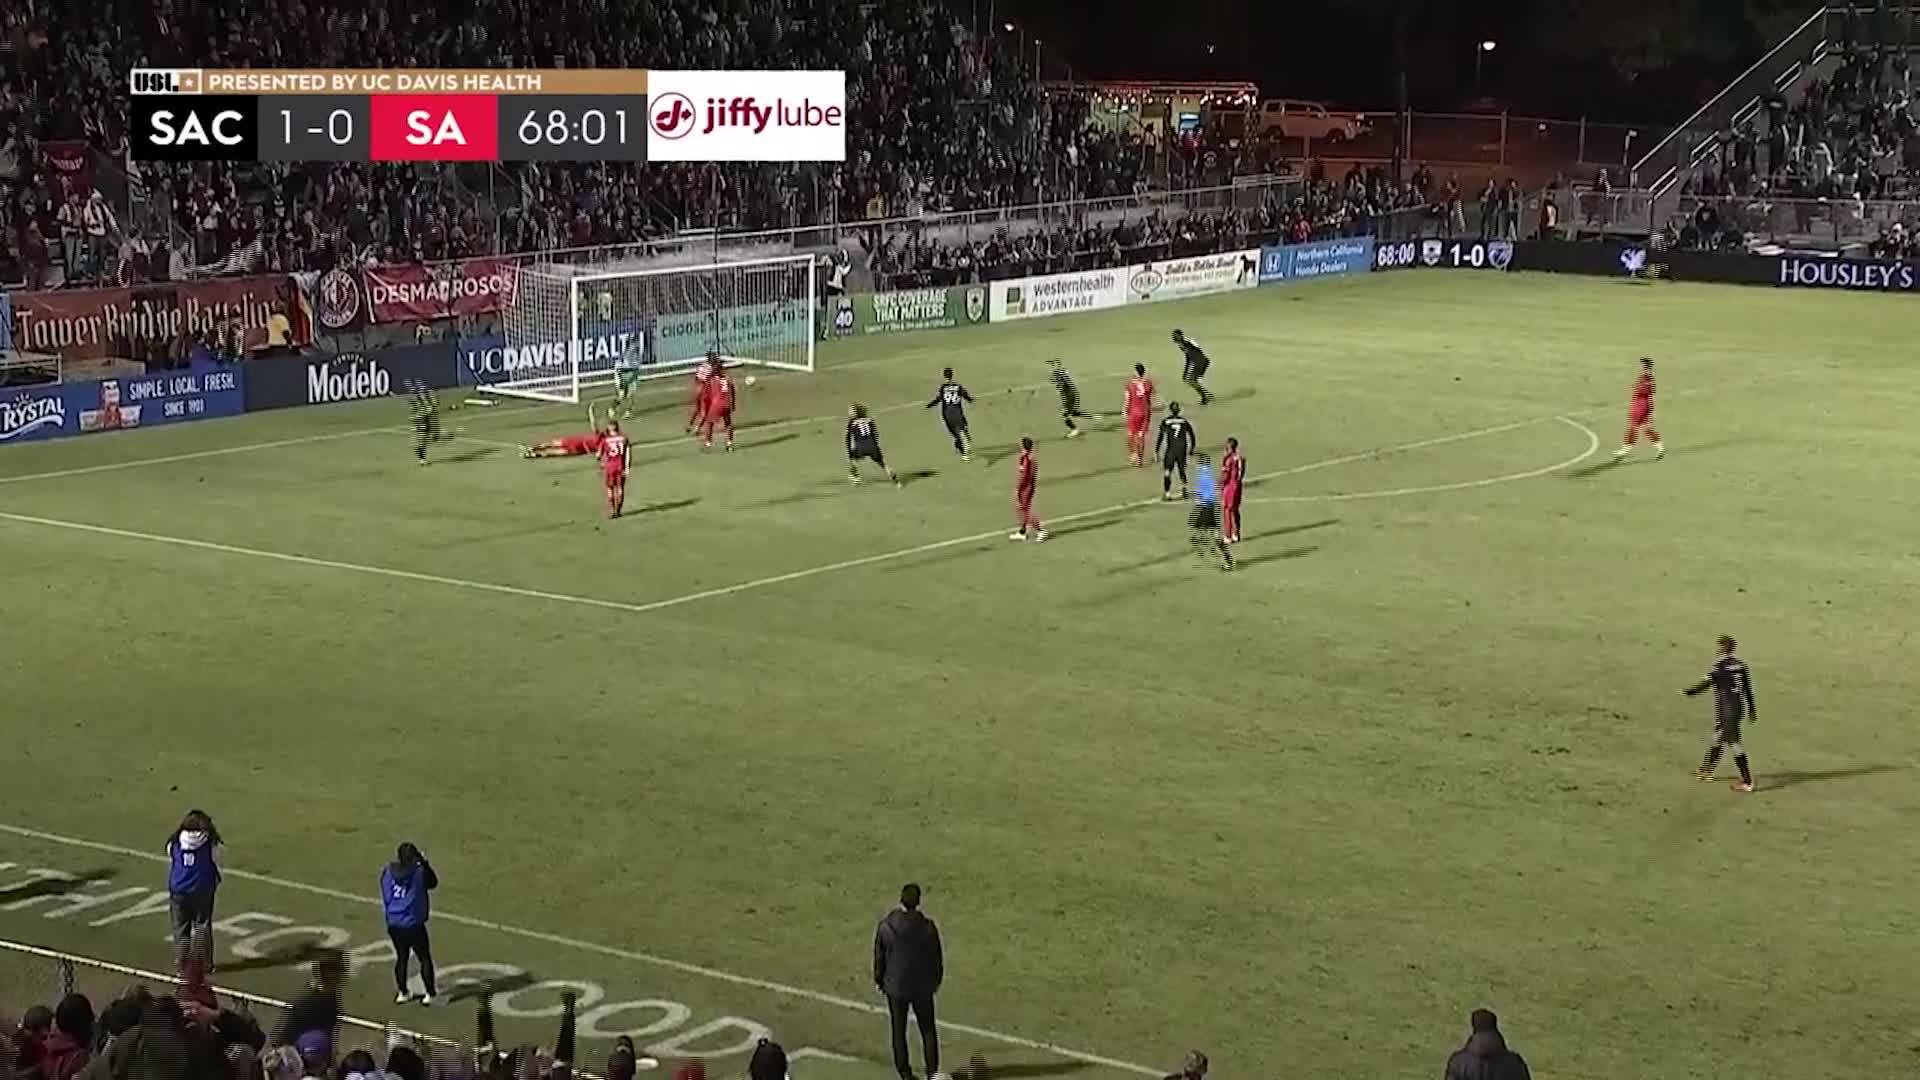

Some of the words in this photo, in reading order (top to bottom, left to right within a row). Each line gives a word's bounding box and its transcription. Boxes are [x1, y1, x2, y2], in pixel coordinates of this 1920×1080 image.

[1377, 242, 1415, 266] 68:00
[1450, 244, 1485, 267] 1-0
[1780, 259, 1913, 288] HOUSLEY'S
[16, 310, 101, 350] Tower
[308, 360, 390, 403] Modelo
